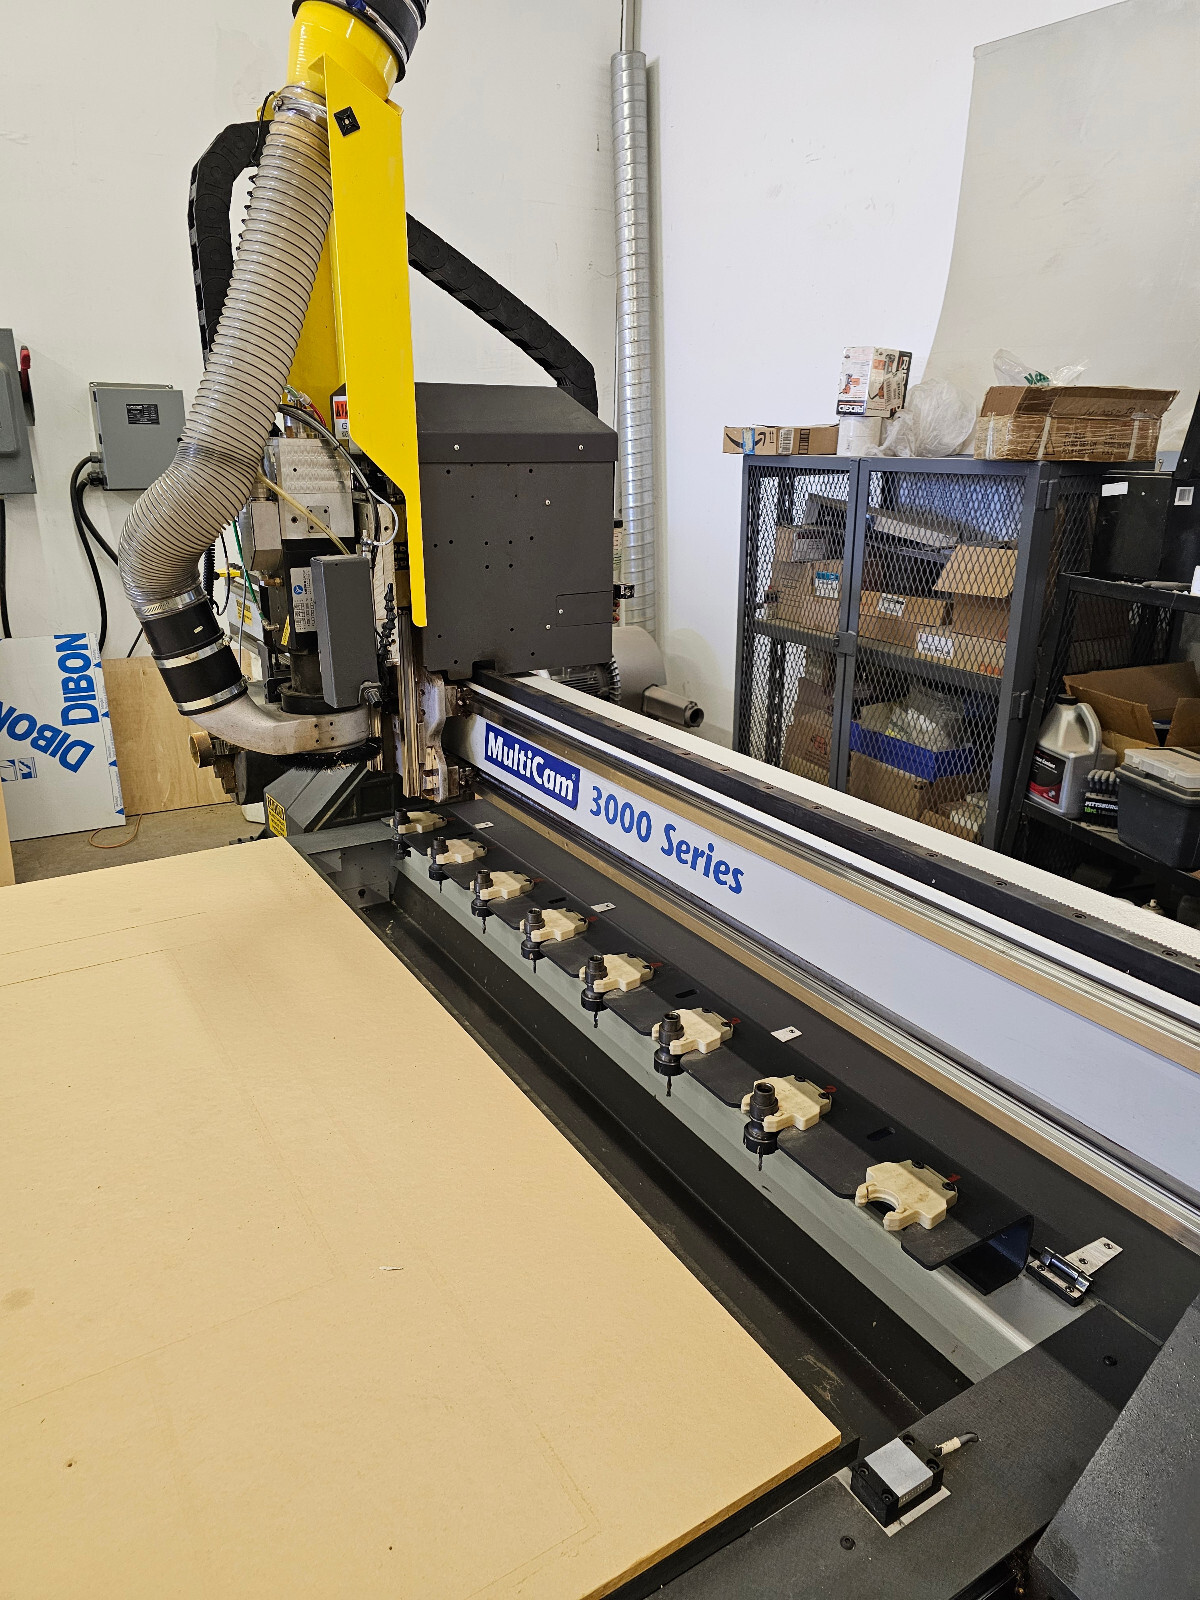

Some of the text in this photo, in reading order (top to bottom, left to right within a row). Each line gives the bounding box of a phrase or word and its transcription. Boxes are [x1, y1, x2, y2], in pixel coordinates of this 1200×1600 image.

[838, 404, 864, 413] RIDGID
[53, 632, 100, 727] DIBON
[487, 731, 745, 895] MultiCam 3000 Series
[1084, 800, 1119, 810] PITTSBURG
